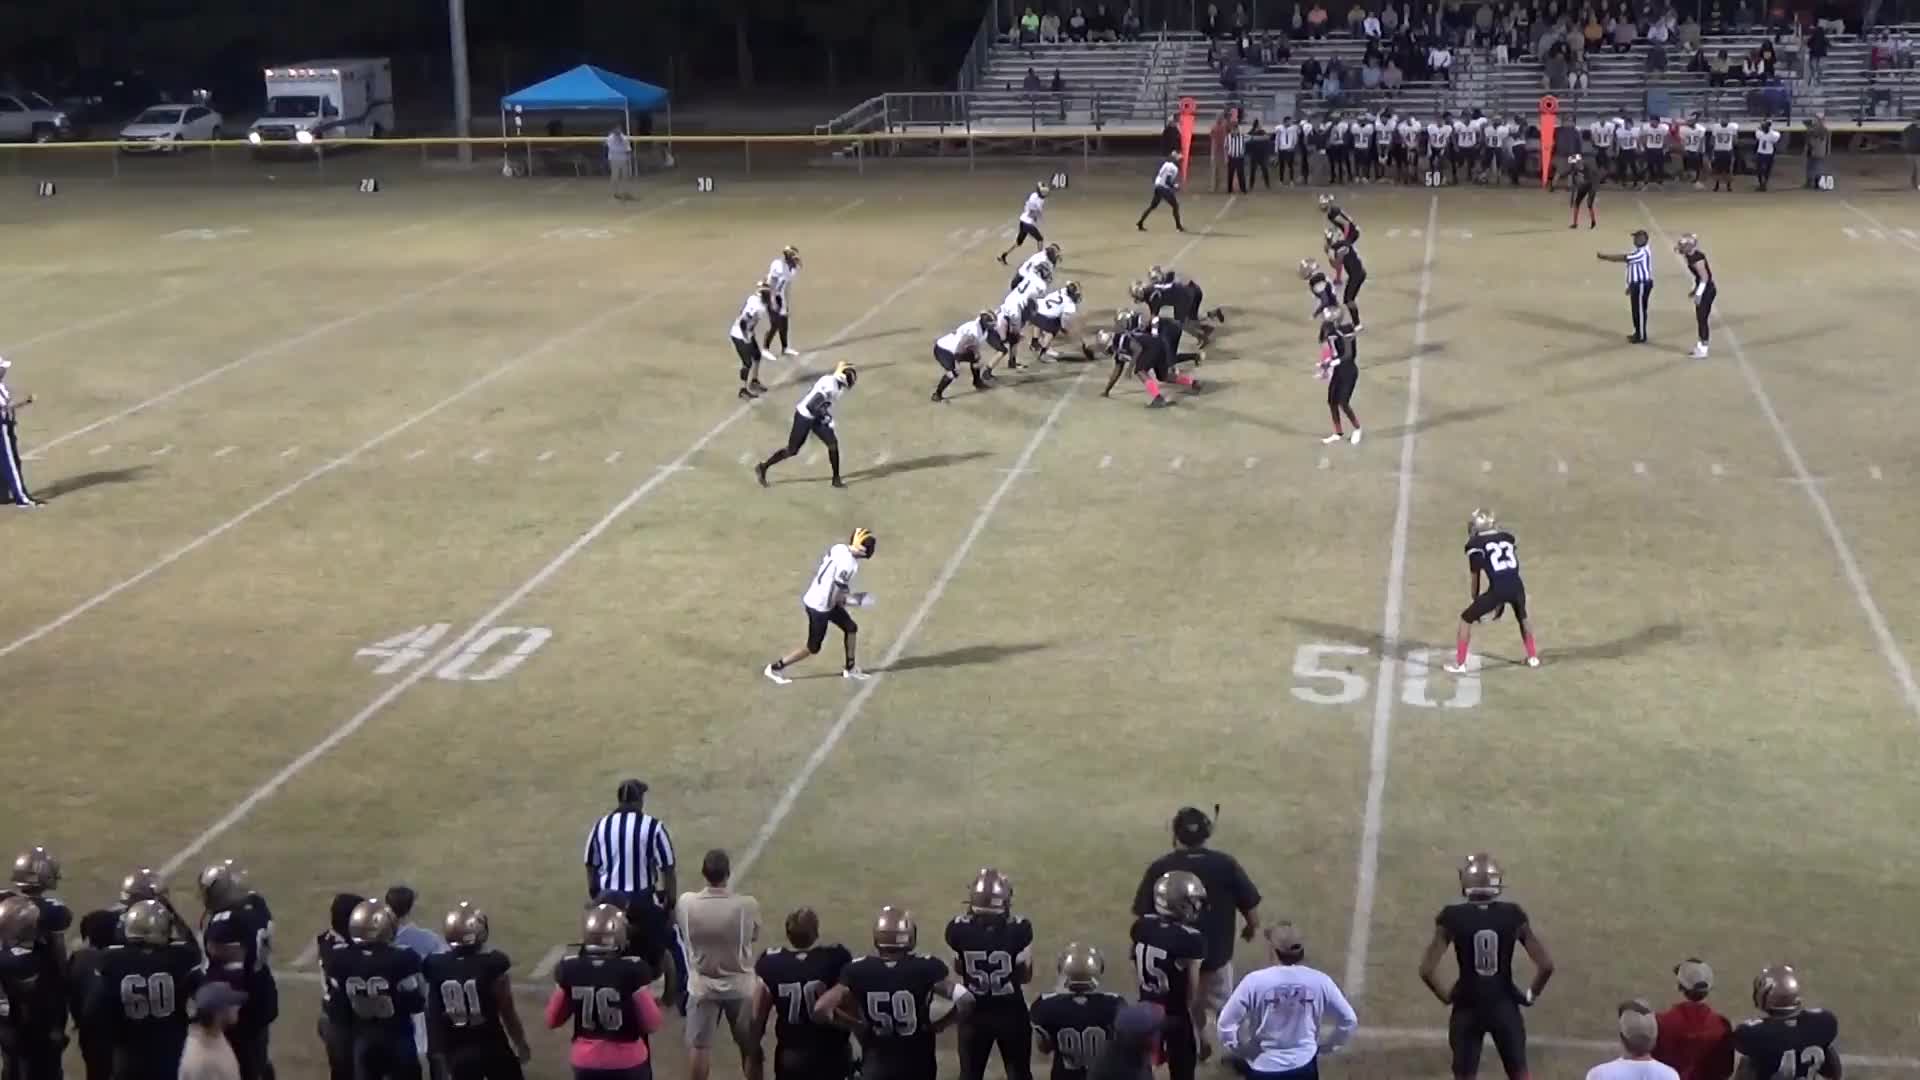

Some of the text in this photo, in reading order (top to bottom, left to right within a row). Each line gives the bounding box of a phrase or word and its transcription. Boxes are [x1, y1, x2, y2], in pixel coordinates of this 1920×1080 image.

[361, 178, 374, 192] 20
[697, 177, 712, 192] 30
[1052, 173, 1066, 188] 40
[1425, 171, 1440, 187] 50
[1818, 175, 1834, 190] 40
[1485, 541, 1517, 572] 23
[354, 623, 552, 680] 40
[1290, 644, 1482, 708] 50
[963, 950, 1015, 996] 52
[1136, 942, 1170, 994] 15
[1474, 929, 1498, 976] 8
[120, 971, 176, 1020] 60
[345, 976, 395, 1018] 66
[571, 986, 624, 1032] 76
[866, 990, 918, 1037] 59
